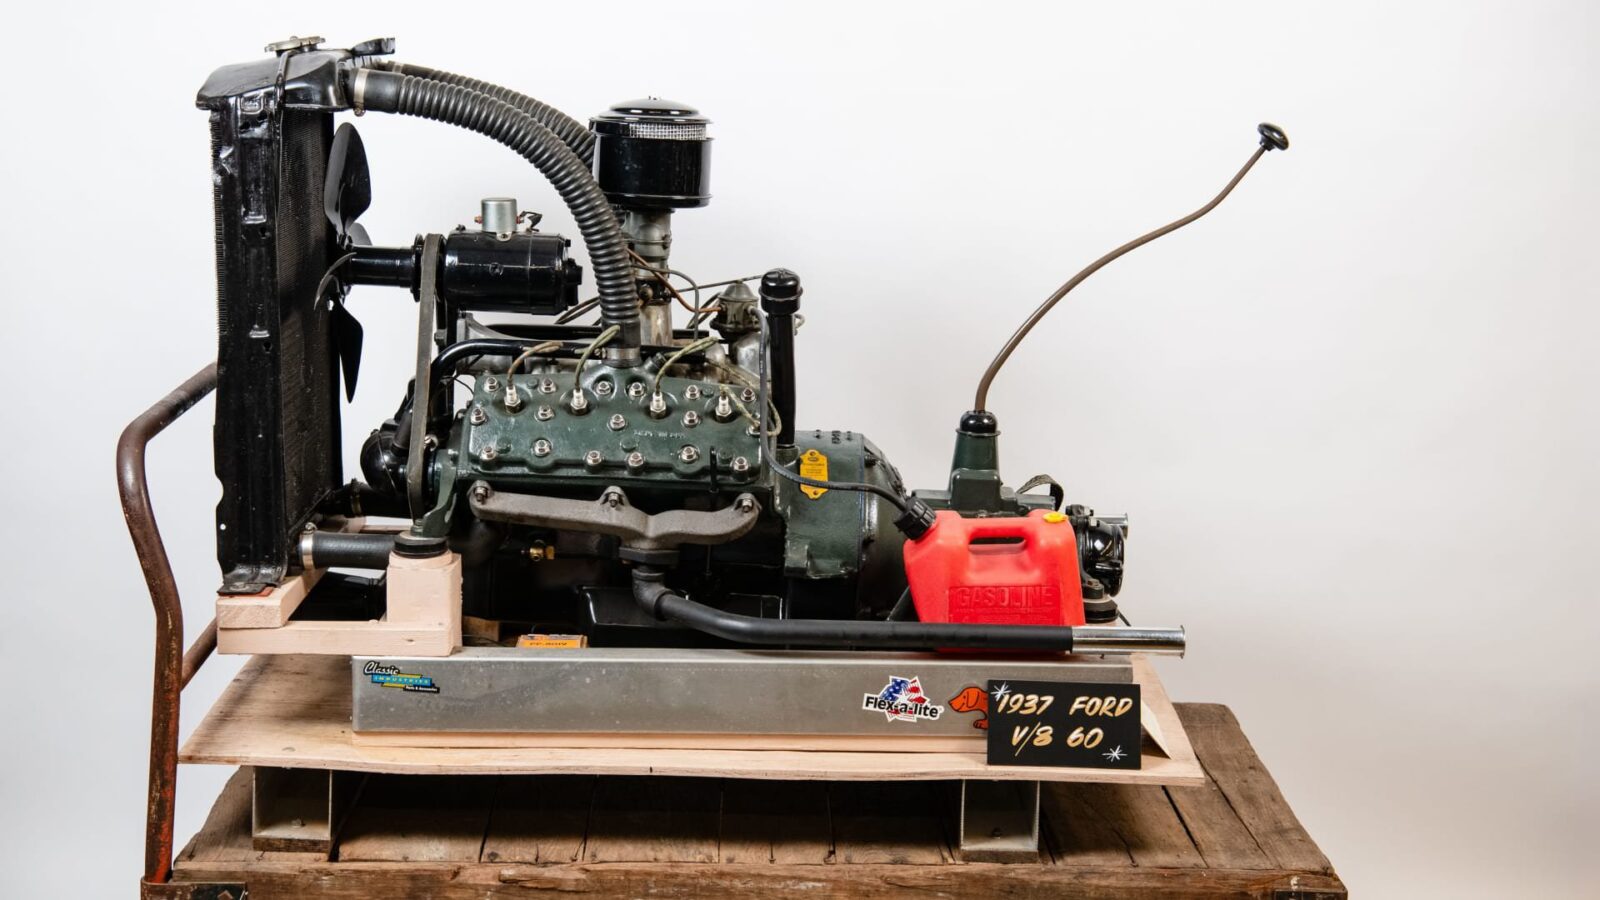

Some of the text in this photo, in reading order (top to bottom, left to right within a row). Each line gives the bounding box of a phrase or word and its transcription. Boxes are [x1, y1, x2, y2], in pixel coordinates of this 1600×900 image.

[956, 586, 1054, 607] GASOLINE
[364, 661, 399, 675] Classic
[865, 696, 939, 717] Flex-a-lite
[997, 693, 1133, 717] 1937 FORD
[1012, 721, 1105, 757] V/8 60
